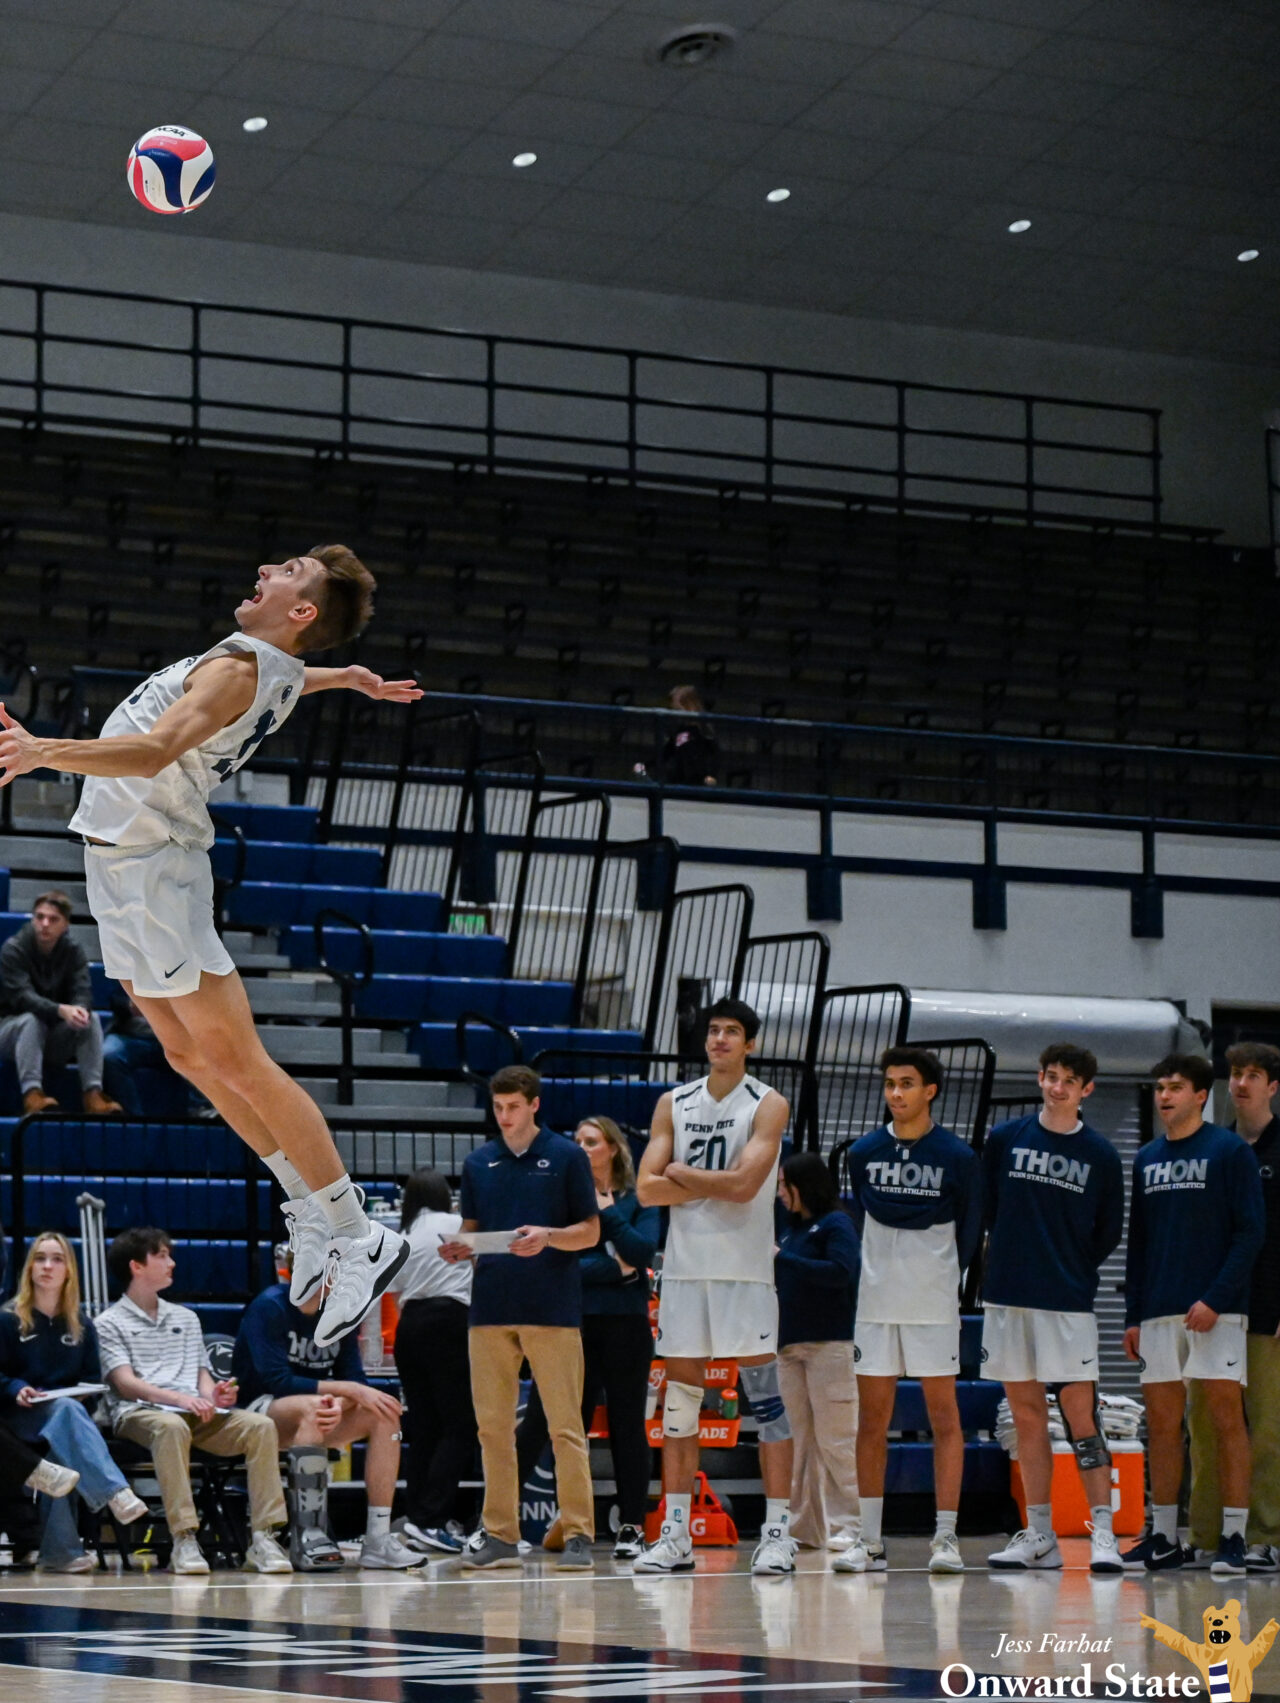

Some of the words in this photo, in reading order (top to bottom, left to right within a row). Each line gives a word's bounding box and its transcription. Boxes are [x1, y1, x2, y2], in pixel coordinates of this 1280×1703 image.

[684, 1123, 714, 1134] PENN
[687, 1135, 726, 1170] 20
[1012, 1147, 1091, 1186] THON
[865, 1161, 943, 1190] THON
[1143, 1159, 1209, 1187] THON
[902, 1187, 941, 1198] ATHLETICS
